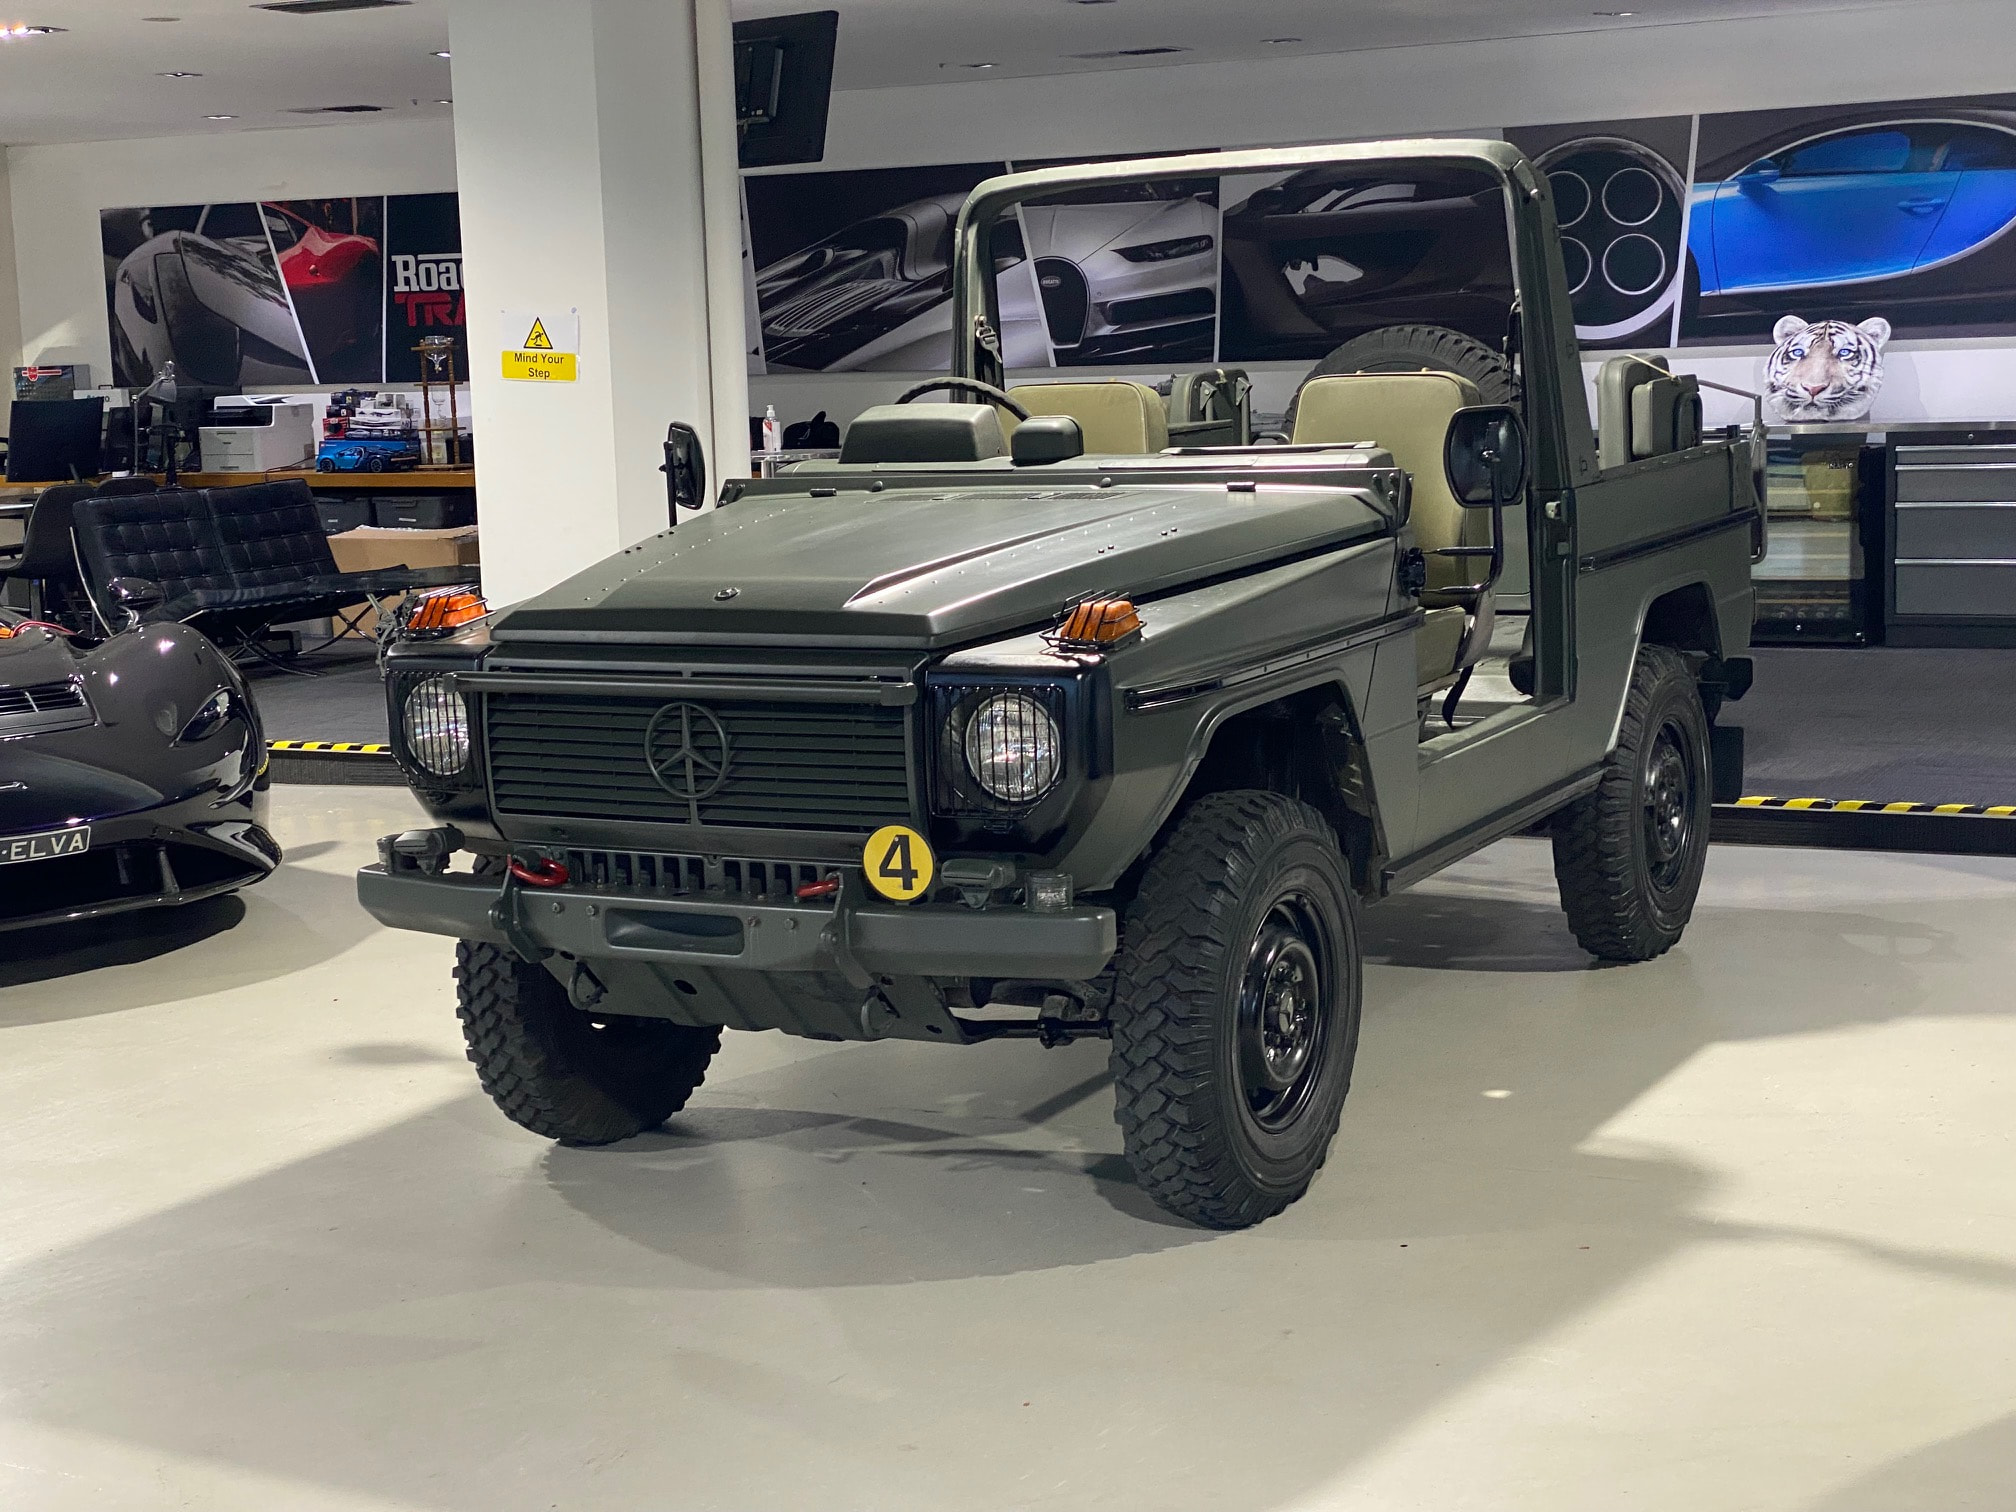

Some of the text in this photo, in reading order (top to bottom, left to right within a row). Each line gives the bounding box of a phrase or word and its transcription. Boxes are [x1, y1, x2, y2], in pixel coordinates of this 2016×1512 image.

[391, 253, 464, 292] Roa
[514, 353, 564, 364] Mind Your
[528, 367, 551, 380] Step
[879, 834, 919, 891] 4
